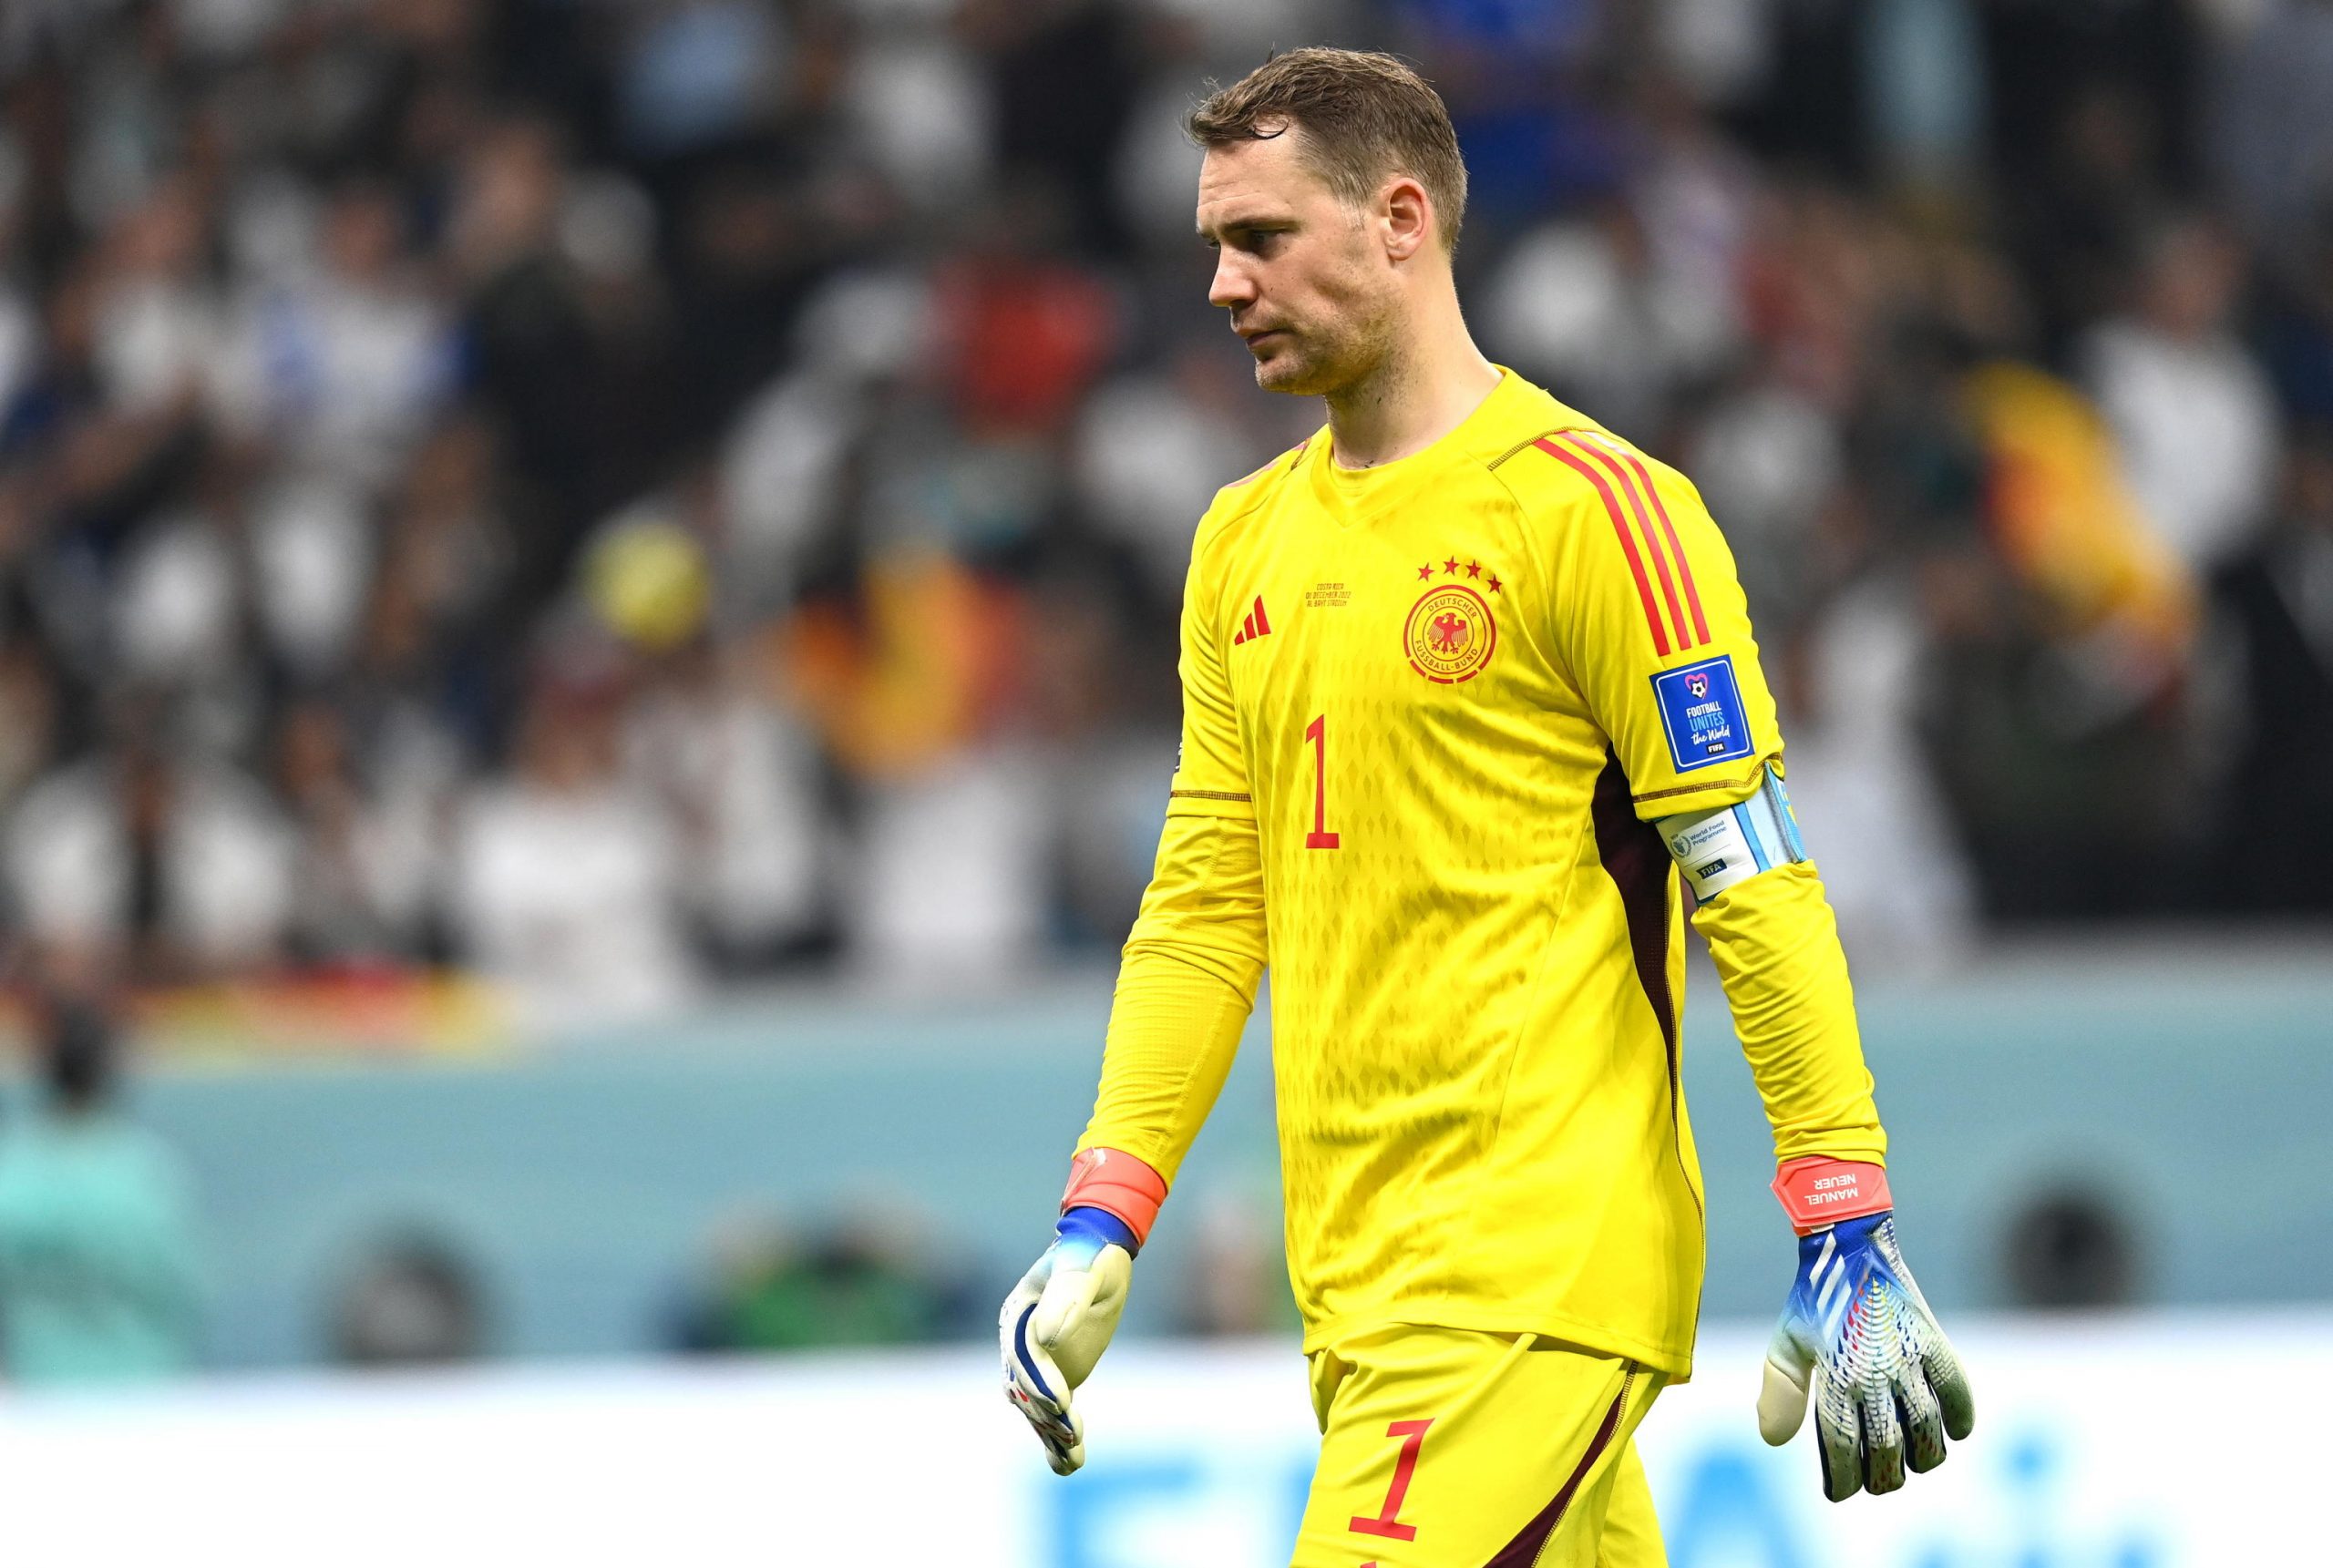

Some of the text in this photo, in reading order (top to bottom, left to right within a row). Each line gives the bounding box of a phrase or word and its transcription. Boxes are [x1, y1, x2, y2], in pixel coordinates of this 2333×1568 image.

[1428, 598, 1477, 619] DEUTSCHER
[1415, 640, 1478, 671] FUSSBALL-BUND
[1686, 701, 1721, 718] FOOTBALL
[1689, 712, 1725, 732] UNITES
[1691, 724, 1731, 745] the World
[1707, 743, 1724, 753] FIFA
[1305, 713, 1340, 849] 1
[1690, 828, 1709, 841] World
[1709, 820, 1725, 831] Food
[1691, 826, 1727, 846] Programme
[1701, 862, 1721, 876] FIFA
[1814, 1173, 1856, 1190] NEUER
[1804, 1187, 1858, 1205] MANUEL
[1349, 1417, 1436, 1542] 1
